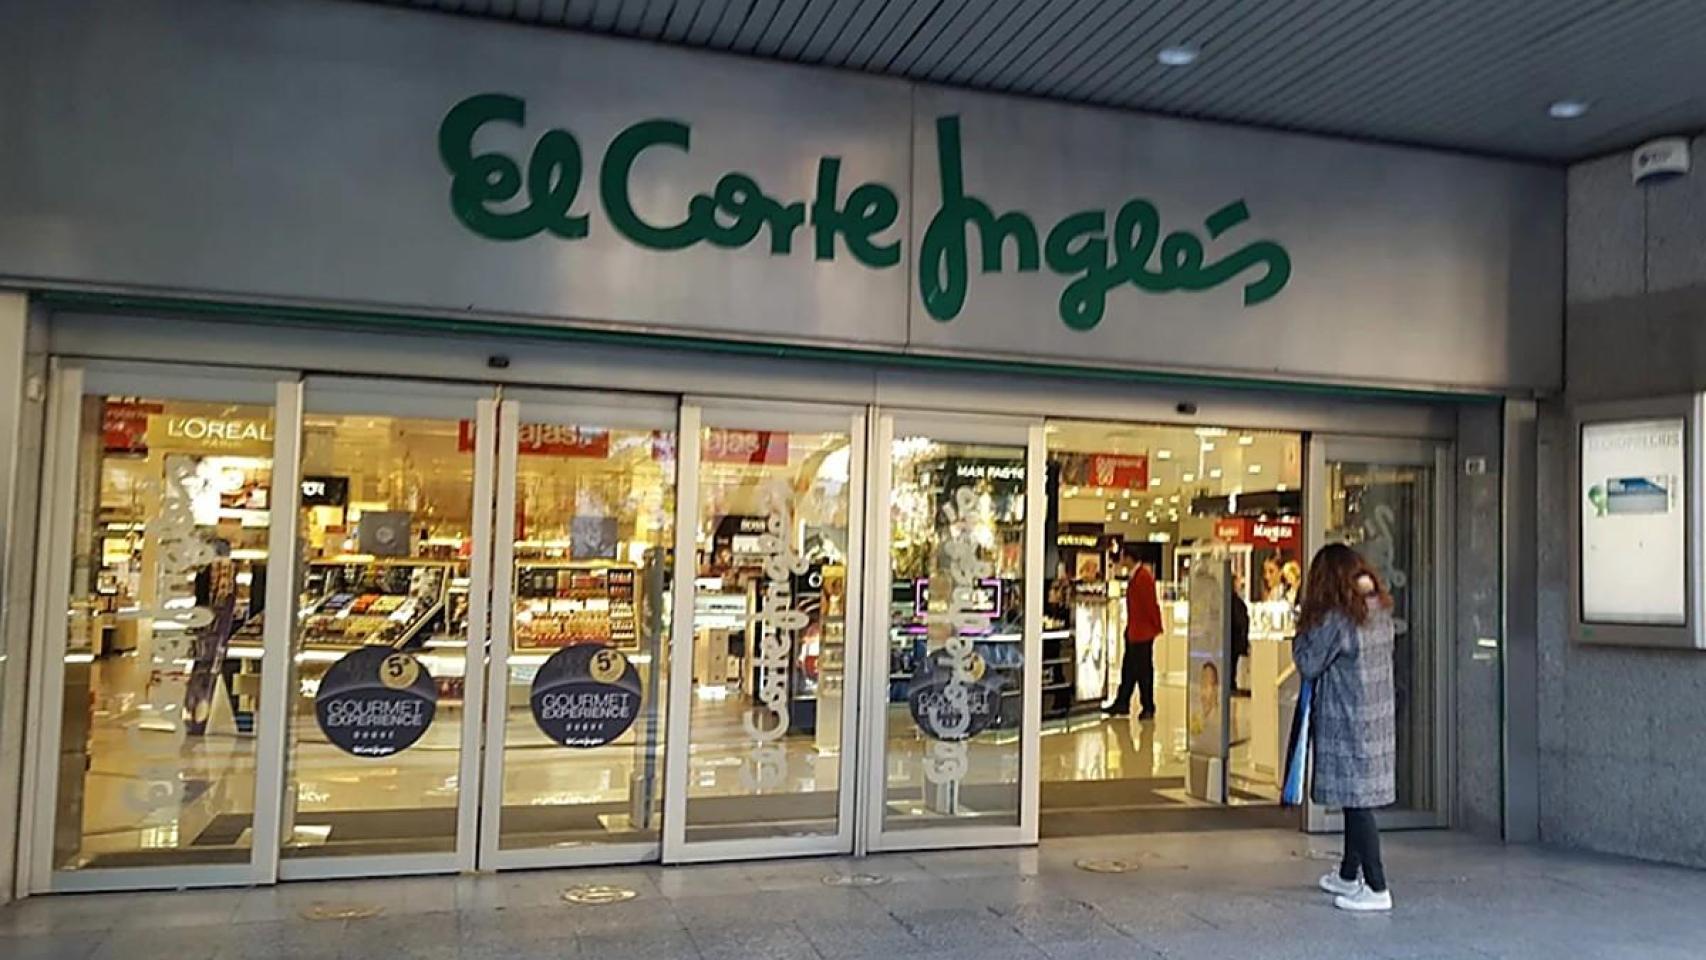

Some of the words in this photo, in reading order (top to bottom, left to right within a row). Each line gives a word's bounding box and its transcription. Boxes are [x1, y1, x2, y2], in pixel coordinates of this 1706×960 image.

[439, 94, 589, 241] El
[601, 119, 901, 269] Corte
[919, 114, 1292, 331] Inglés
[327, 699, 424, 716] GOURMET
[541, 692, 630, 709] GOURMET
[327, 713, 423, 726] EXPERIENCE
[541, 706, 629, 719] EXPERIENCE
